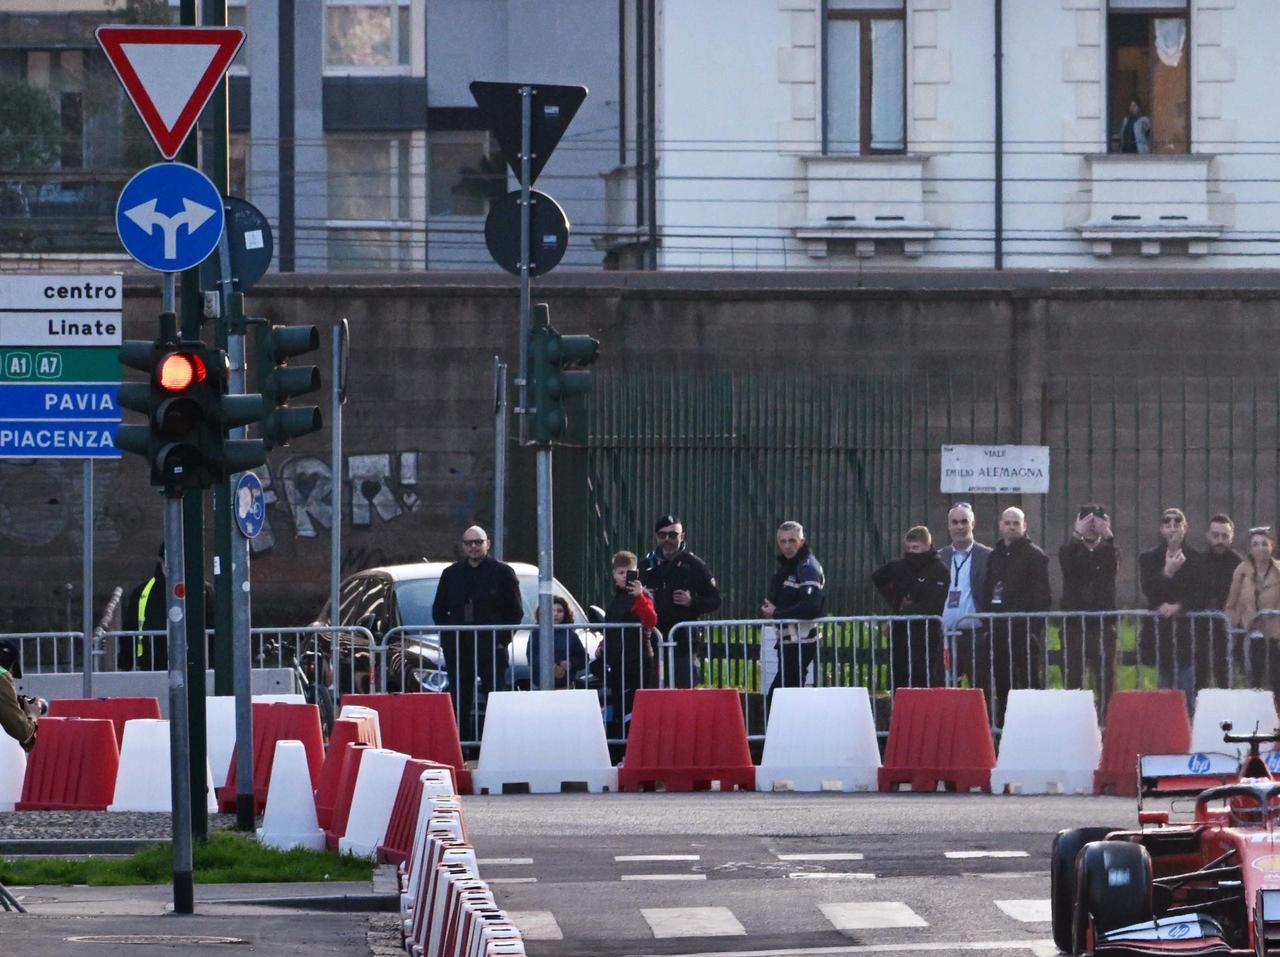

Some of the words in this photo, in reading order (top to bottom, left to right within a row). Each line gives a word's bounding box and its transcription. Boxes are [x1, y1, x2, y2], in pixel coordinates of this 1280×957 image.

[44, 283, 117, 299] centro
[48, 319, 116, 335] Linate
[10, 357, 26, 373] A1
[40, 357, 57, 373] A7
[45, 393, 114, 411] PAVIA
[0, 430, 114, 447] PIACENZA
[978, 466, 1043, 478] ALEMAGNA
[1189, 753, 1209, 774] hp
